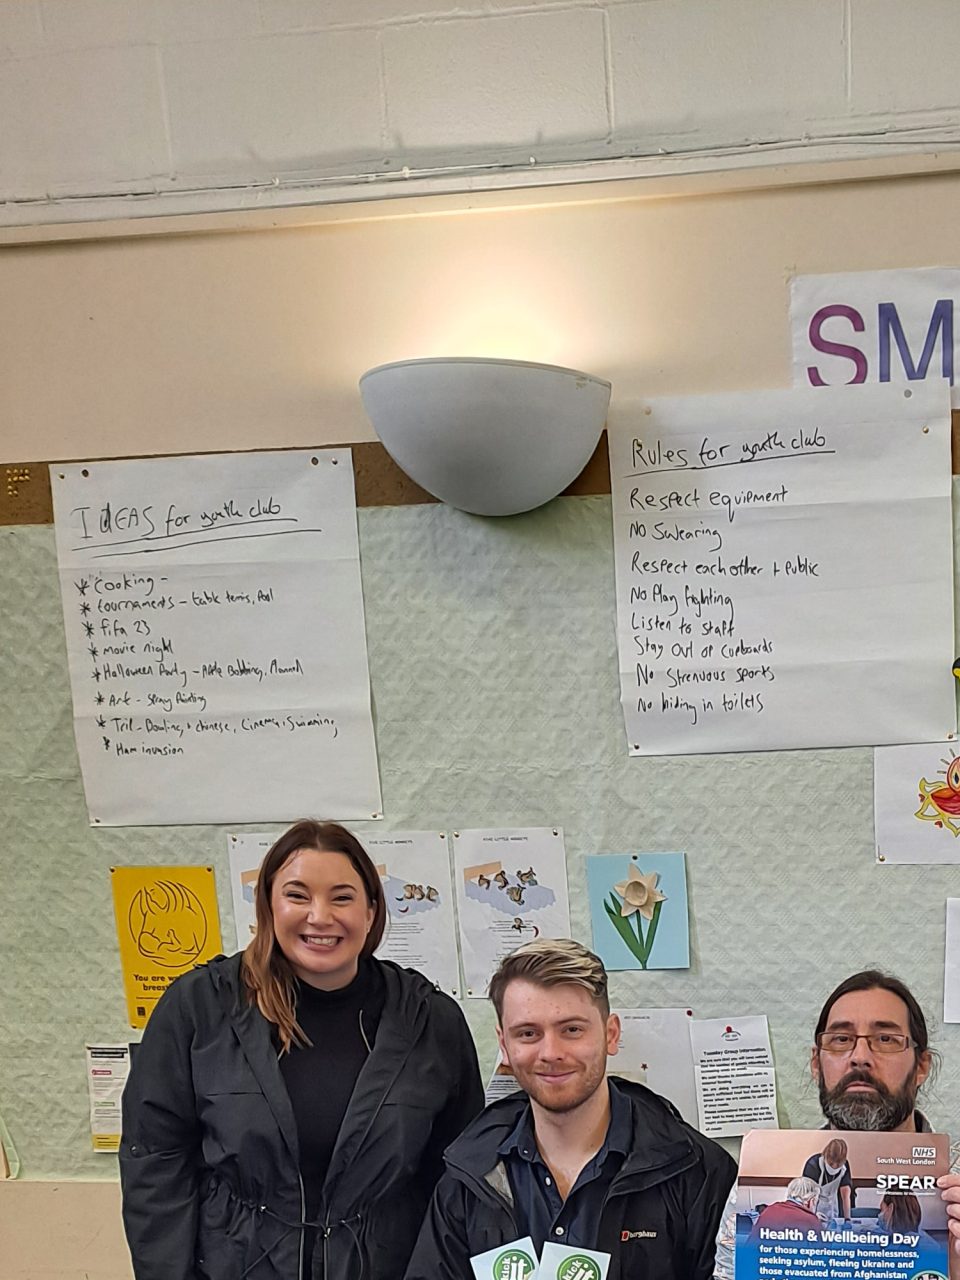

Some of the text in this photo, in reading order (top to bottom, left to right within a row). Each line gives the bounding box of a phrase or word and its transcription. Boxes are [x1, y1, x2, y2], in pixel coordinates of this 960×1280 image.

[632, 427, 826, 468] Rules for youth club
[630, 485, 788, 522] Respect equipment
[166, 504, 191, 536] for
[200, 500, 243, 527] youth
[250, 497, 281, 518] club
[631, 551, 687, 574] Respect
[696, 556, 726, 576] each
[730, 556, 763, 577] other
[133, 619, 151, 635] 23
[632, 612, 671, 631] Listen
[679, 617, 691, 634] to
[143, 637, 173, 662] night
[637, 662, 654, 686] No
[638, 692, 764, 725] No hiding in toilets
[142, 741, 184, 755] invasion
[913, 1147, 935, 1157] NHS
[876, 1174, 936, 1190] SPEAR
[760, 1227, 920, 1247] Health & Wellbeing Day
[759, 1256, 914, 1269] seeking asylum, fleeing Ukraine and
[760, 1245, 919, 1259] for those experiencing homelessness,
[759, 1267, 907, 1280] those evacuated from Afghanistan
